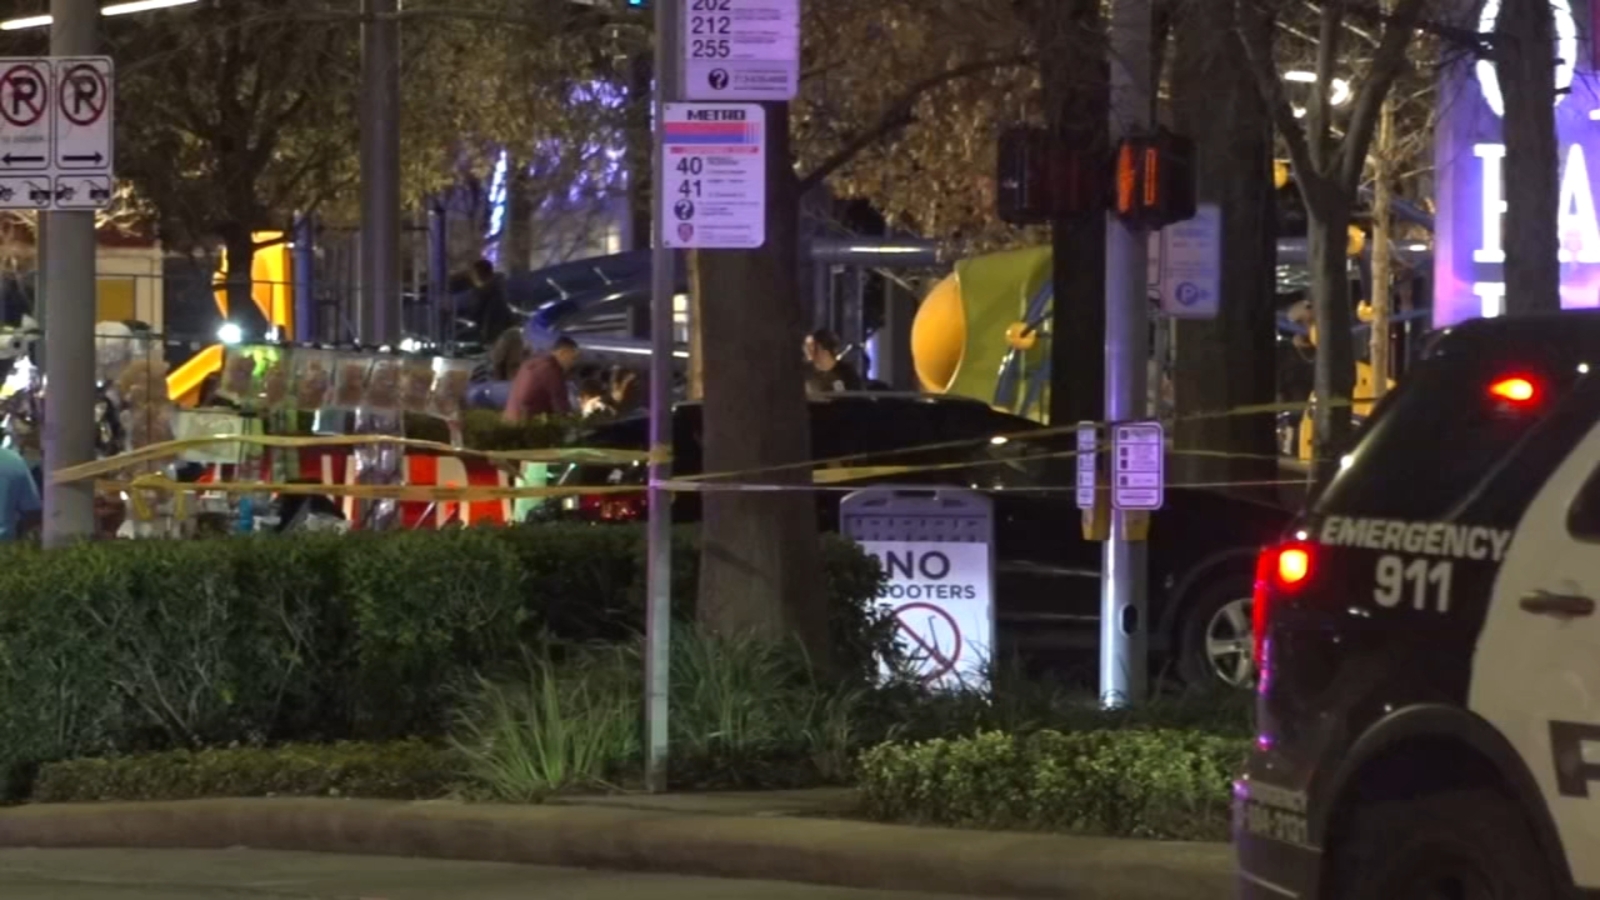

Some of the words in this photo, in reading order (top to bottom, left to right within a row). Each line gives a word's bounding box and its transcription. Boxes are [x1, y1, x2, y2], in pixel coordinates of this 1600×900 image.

[692, 16, 730, 34] 212
[692, 39, 730, 57] 255
[687, 109, 746, 120] METRO
[676, 156, 703, 175] 40
[678, 179, 702, 198] 41
[1320, 516, 1511, 561] EMERGENCY
[886, 551, 951, 580] NO
[877, 584, 976, 599] OOTERS
[1373, 555, 1453, 612] 911
